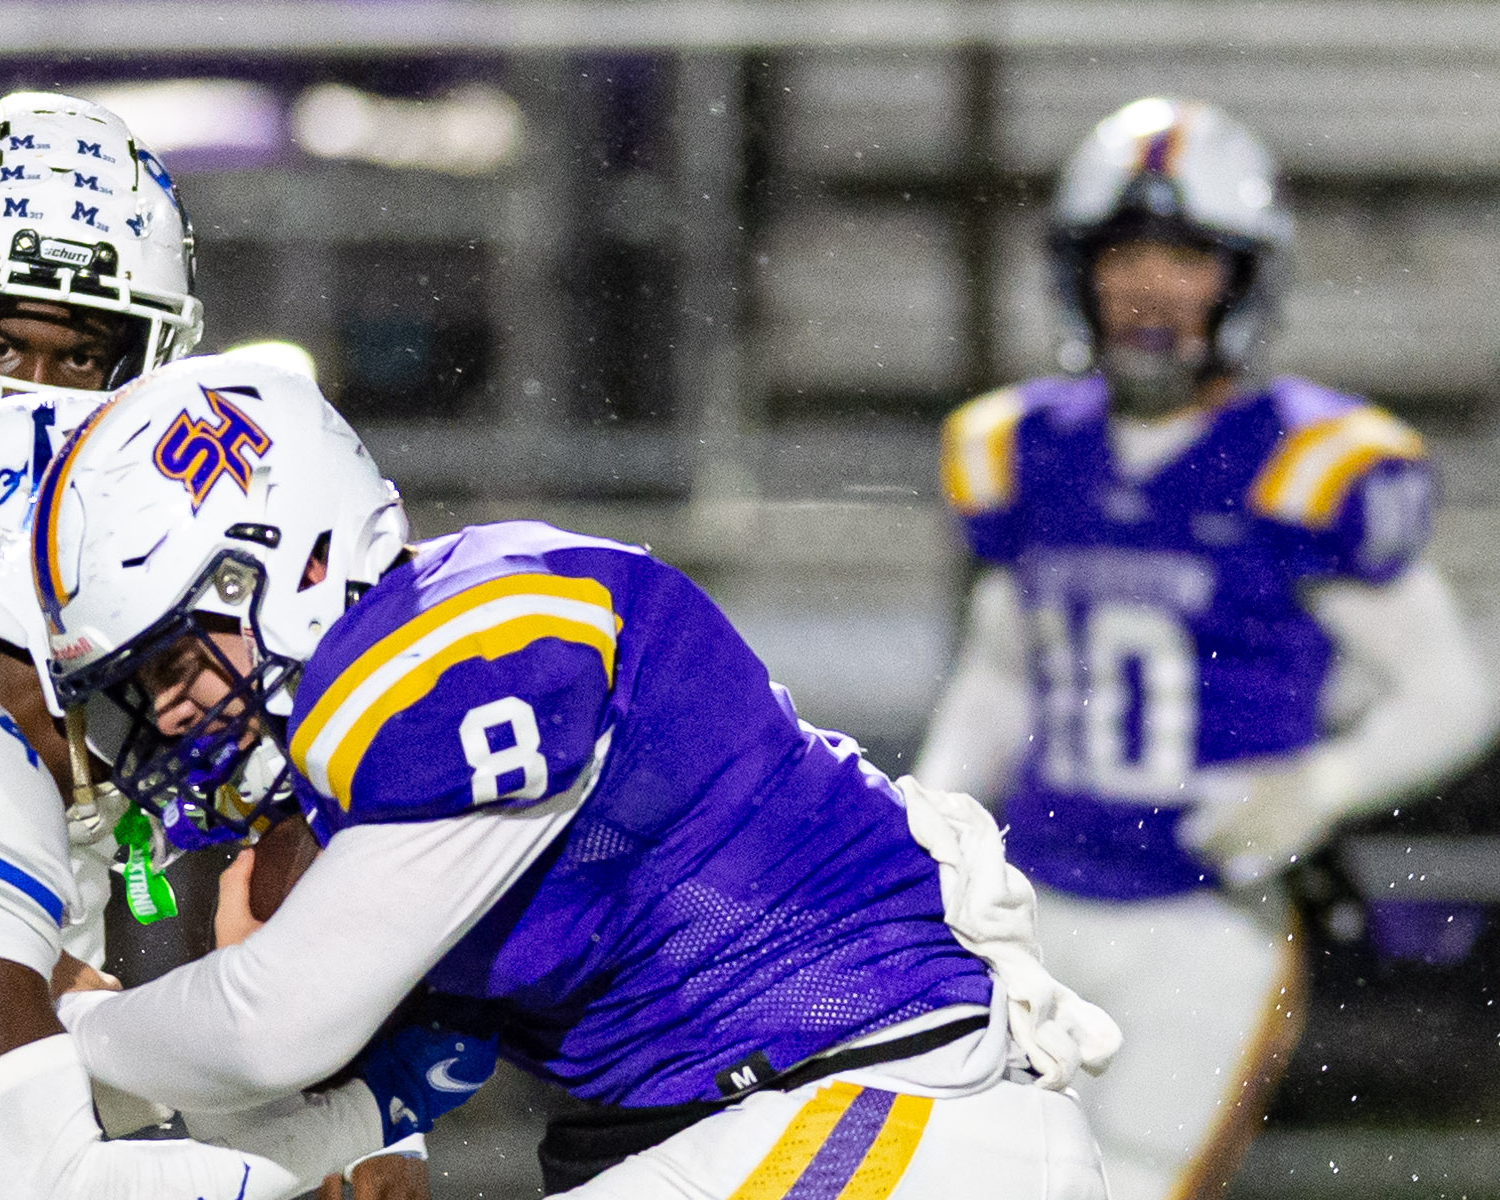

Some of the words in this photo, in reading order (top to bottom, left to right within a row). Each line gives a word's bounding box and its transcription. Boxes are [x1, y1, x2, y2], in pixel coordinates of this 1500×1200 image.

[10, 135, 35, 150] M
[77, 139, 102, 158] M
[0, 165, 26, 182] M
[73, 172, 100, 192] M
[3, 197, 30, 218] M
[71, 200, 99, 226] M
[152, 382, 274, 518] SH
[1032, 603, 1200, 806] 10
[458, 696, 548, 806] 8
[730, 1065, 758, 1090] M
